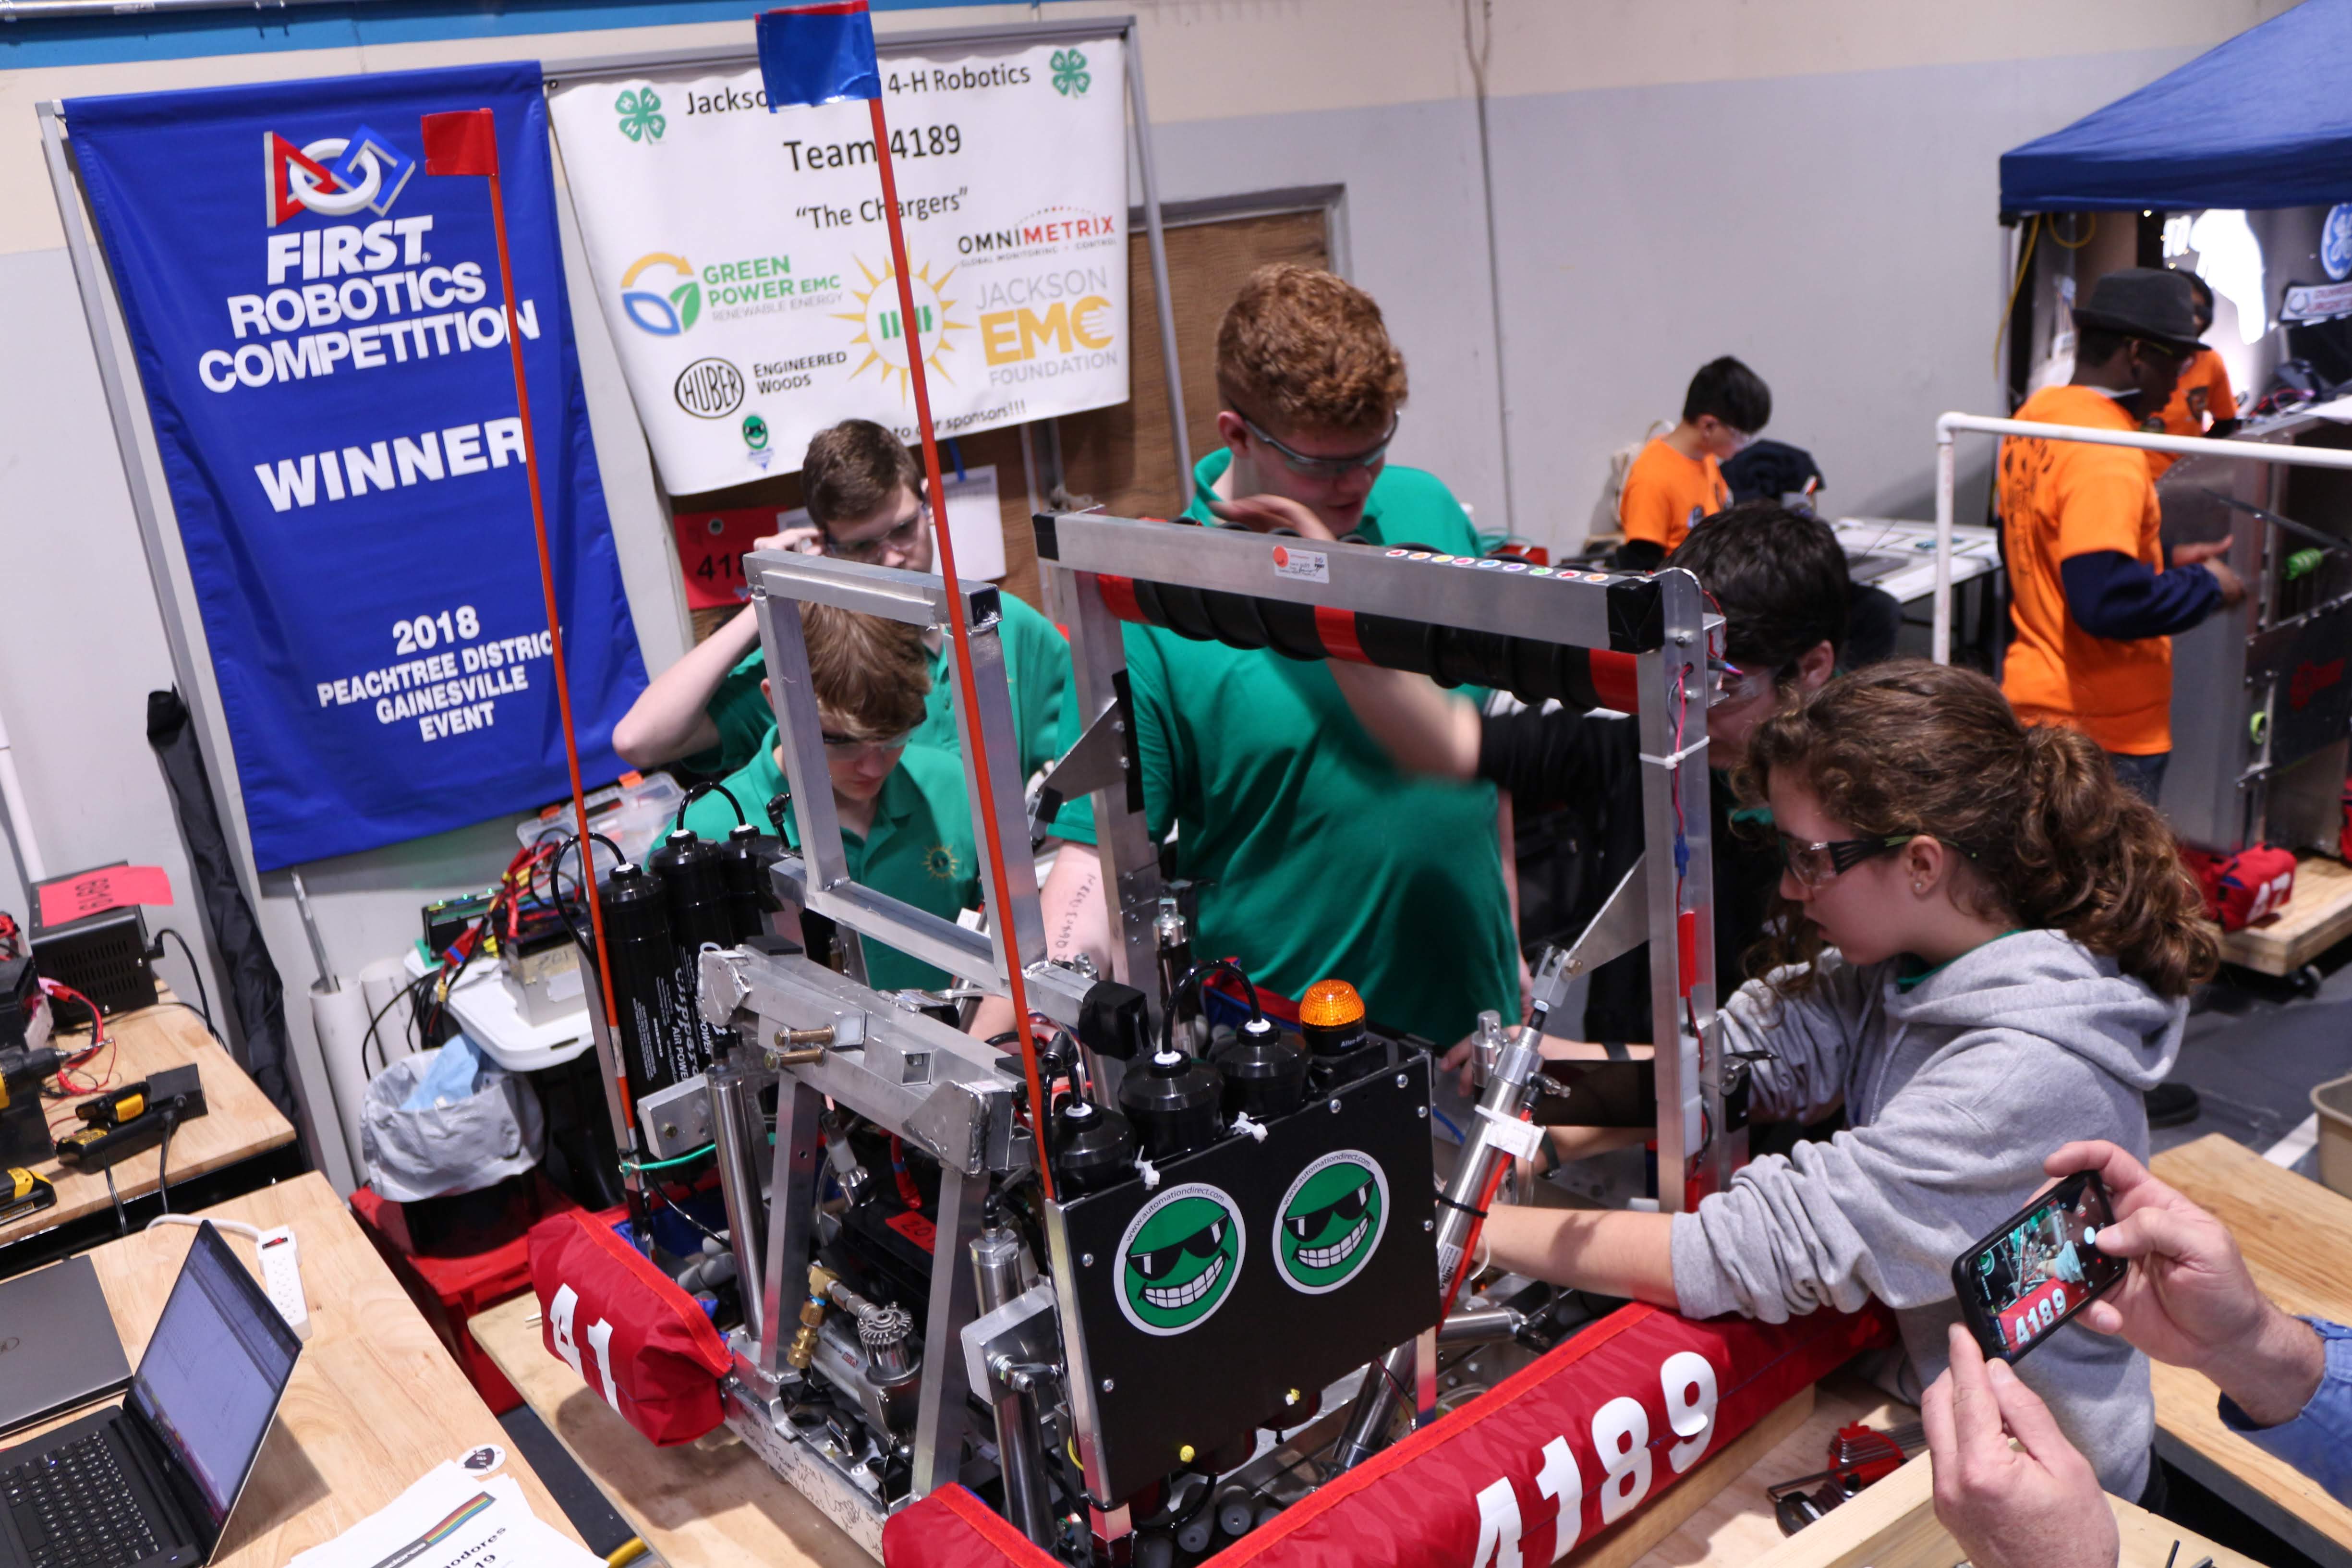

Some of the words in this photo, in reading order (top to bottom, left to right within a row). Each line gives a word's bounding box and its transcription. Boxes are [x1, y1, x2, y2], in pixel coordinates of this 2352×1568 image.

[687, 87, 768, 116] Jackso
[888, 70, 927, 94] 4-H
[934, 63, 1031, 92] Robotics
[783, 140, 877, 171] Team
[891, 123, 961, 159] 4189
[267, 215, 433, 285] FIRST
[958, 216, 1115, 254] OMNIMETRIX
[961, 255, 993, 267] GLOBAL
[996, 247, 1057, 263] MONITORING
[1076, 238, 1117, 250] CONTROL
[703, 254, 791, 285] GREEN
[708, 280, 795, 307] POWER
[800, 275, 841, 293] EMC
[976, 266, 1108, 311] JACKSON
[227, 262, 486, 339] ROBOTICS
[712, 302, 786, 321] RENEWABLE
[790, 291, 843, 309] ENERGY
[199, 299, 540, 394] COMPETITION
[979, 296, 1115, 367] EMC
[684, 365, 740, 412] HUBER
[753, 351, 848, 378] ENGINEERED
[757, 375, 812, 395] WOODS
[989, 351, 1118, 387] FOUNDATION
[946, 401, 1026, 429] sponsors!!!
[255, 417, 527, 512] WINNER
[393, 605, 480, 656] 2018
[317, 652, 459, 708] PEACHTREE
[462, 626, 563, 670] DISTRIC
[376, 666, 528, 724] GAINESVILLE
[419, 702, 494, 742] EVENT
[672, 1027, 682, 1046] AIR
[1283, 1153, 1371, 1206] www.automationdirect.com
[1126, 1186, 1225, 1243] www.automationdirect.com
[2015, 1288, 2066, 1345] 4189
[550, 1283, 625, 1418] 41
[1473, 1351, 1719, 1568] 4189
